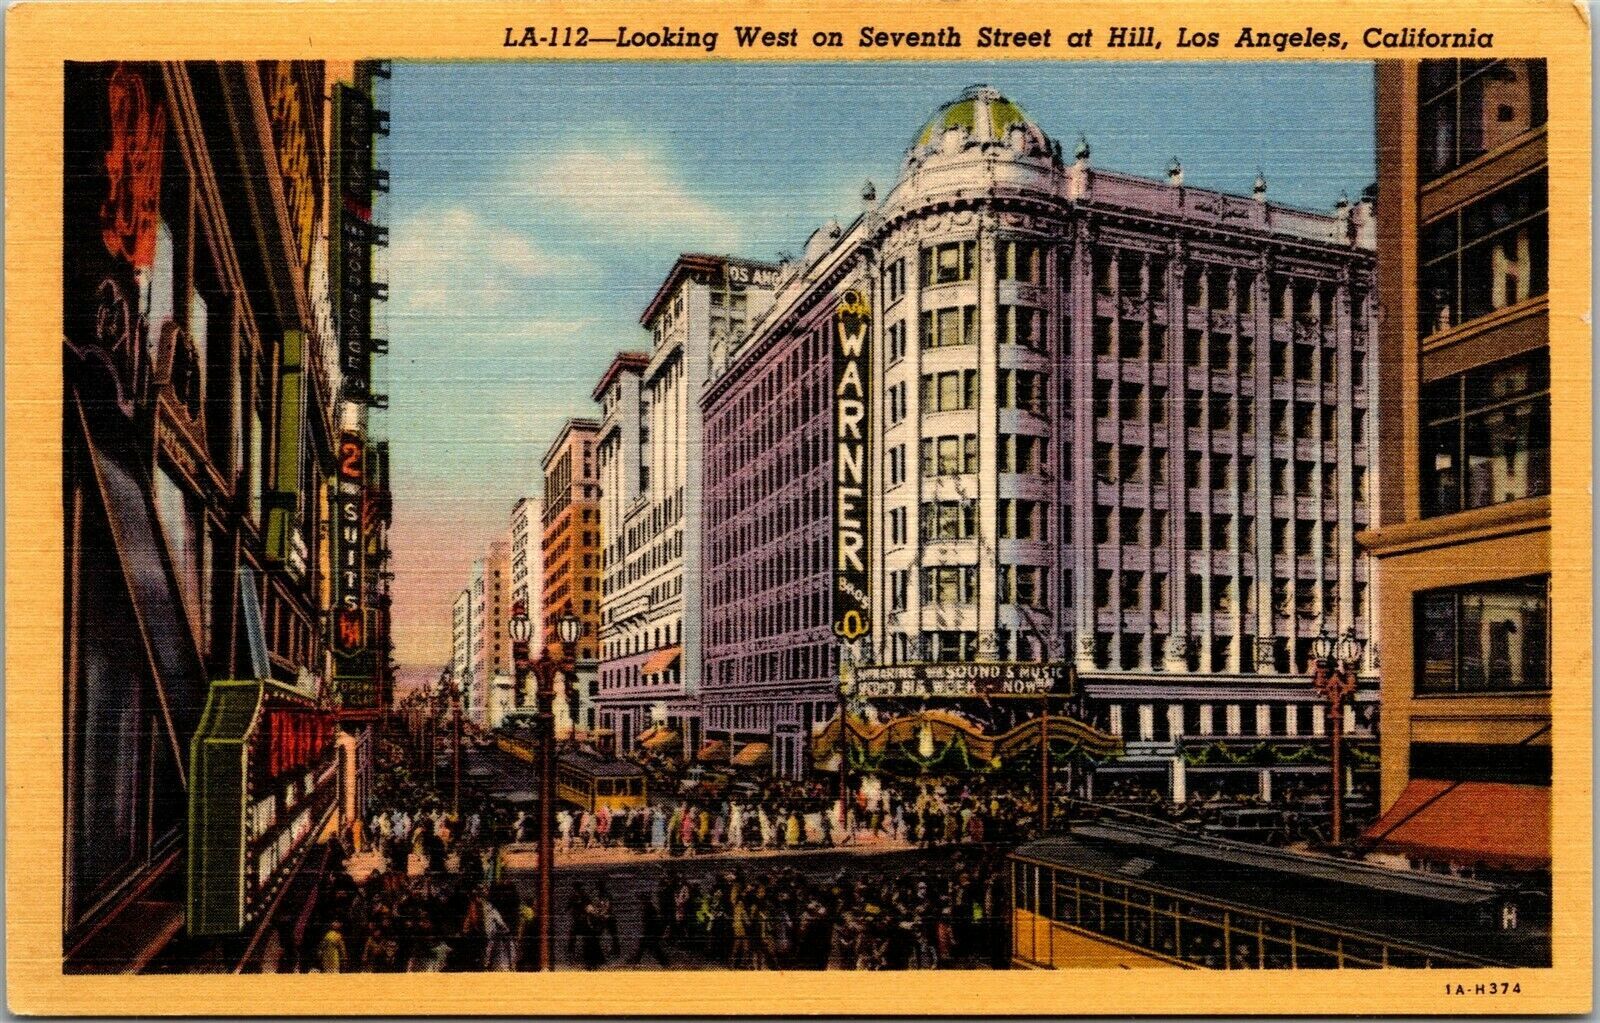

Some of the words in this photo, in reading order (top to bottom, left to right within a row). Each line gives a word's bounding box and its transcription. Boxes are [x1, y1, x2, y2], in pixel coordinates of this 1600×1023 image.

[340, 443, 362, 477] 2
[837, 321, 867, 572] WARNER
[344, 502, 358, 611] SUITS
[946, 665, 1000, 679] SOUND
[1020, 665, 1063, 679] MUSIC
[1502, 906, 1517, 930] H
